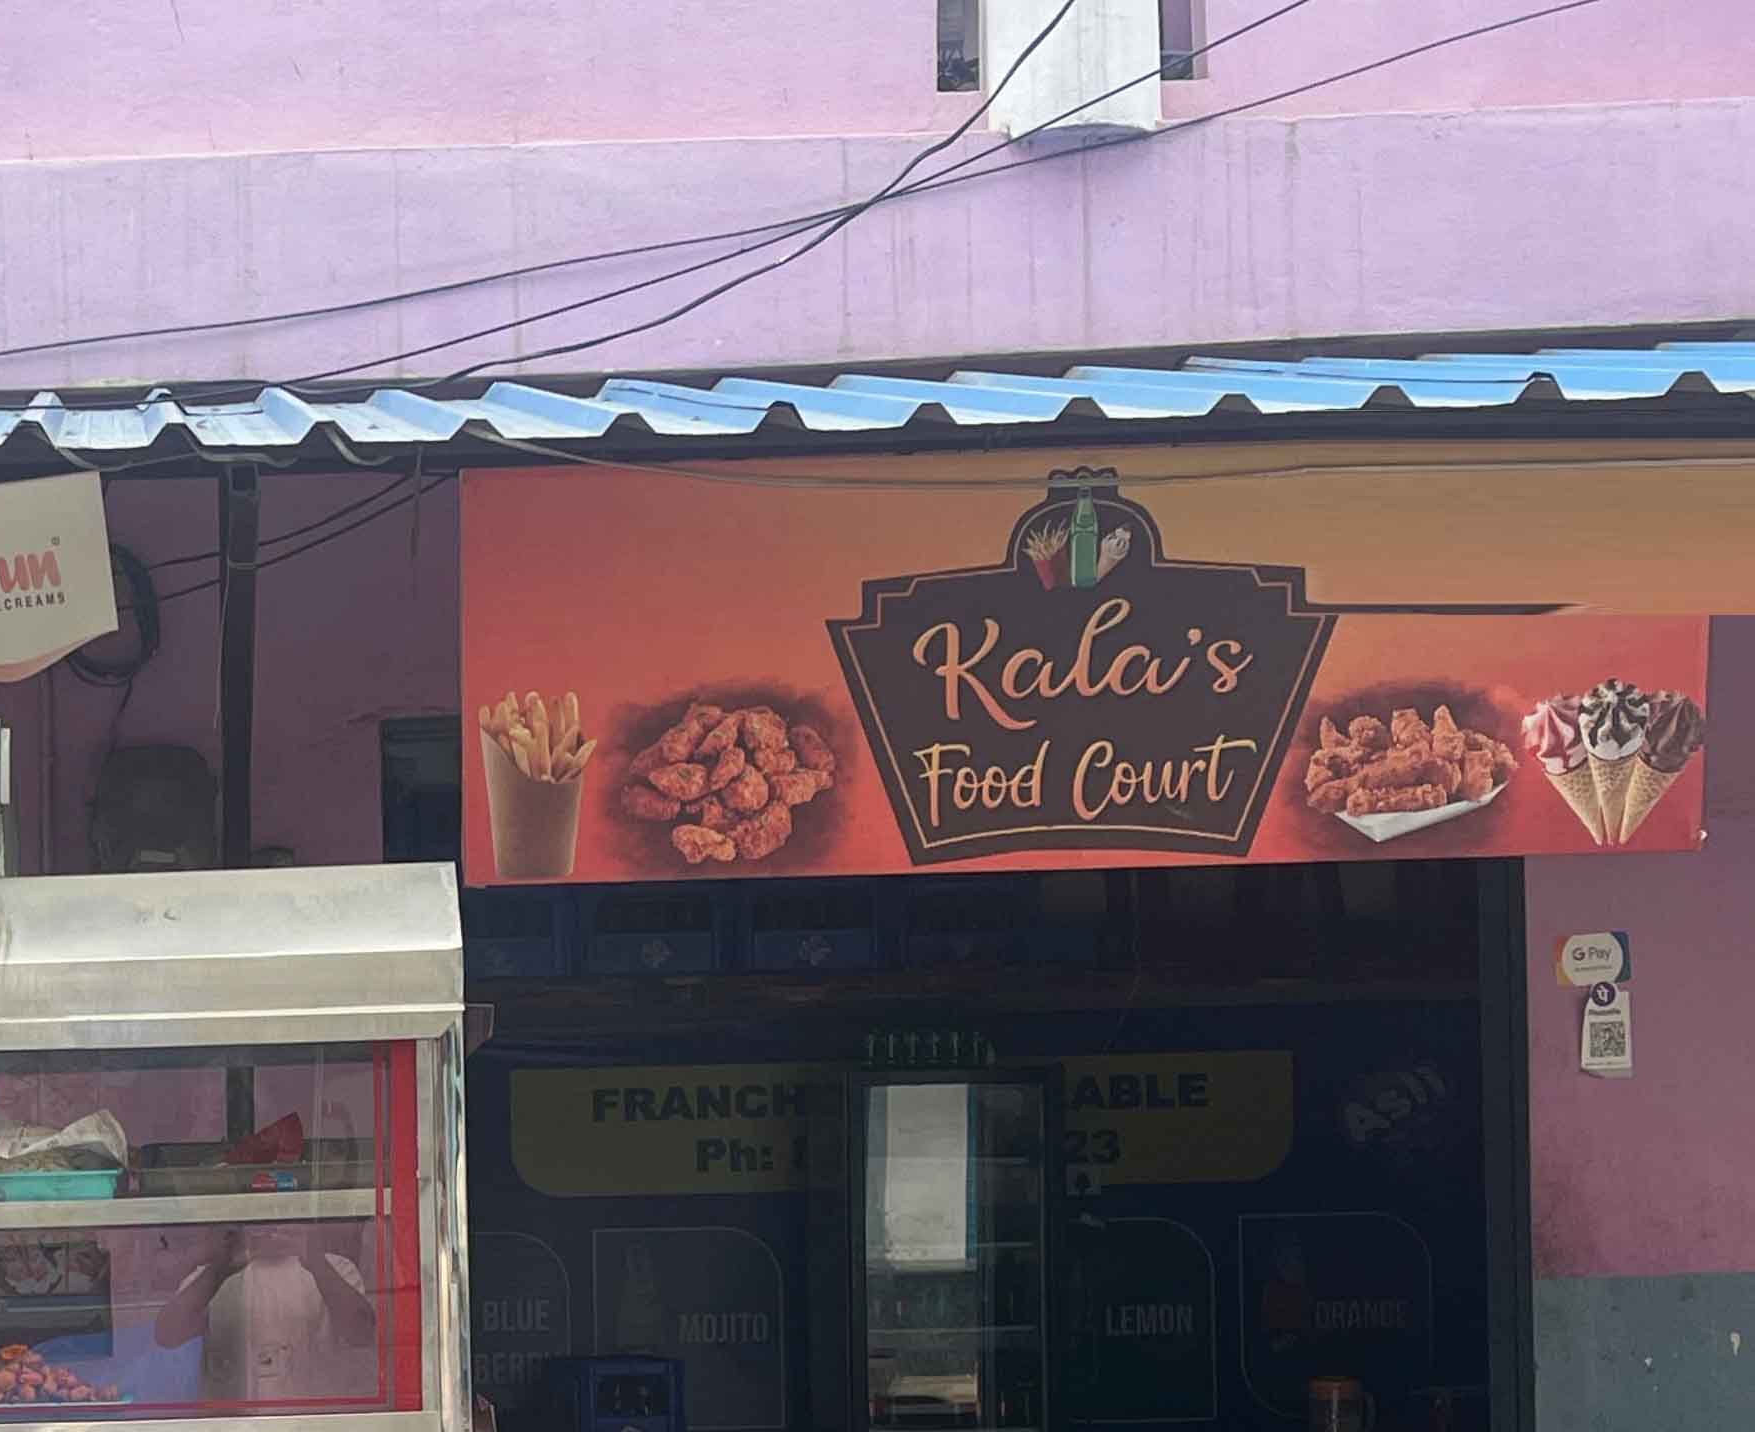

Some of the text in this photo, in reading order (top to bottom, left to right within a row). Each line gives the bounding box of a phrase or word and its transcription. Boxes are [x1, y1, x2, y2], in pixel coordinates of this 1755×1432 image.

[912, 598, 1252, 730] Kala's
[912, 734, 1258, 828] Food Court
[591, 1080, 808, 1122] FRANCH
[482, 1297, 550, 1332] BLUE
[677, 1311, 769, 1345] MOJITO
[1104, 1303, 1194, 1337] LEMON
